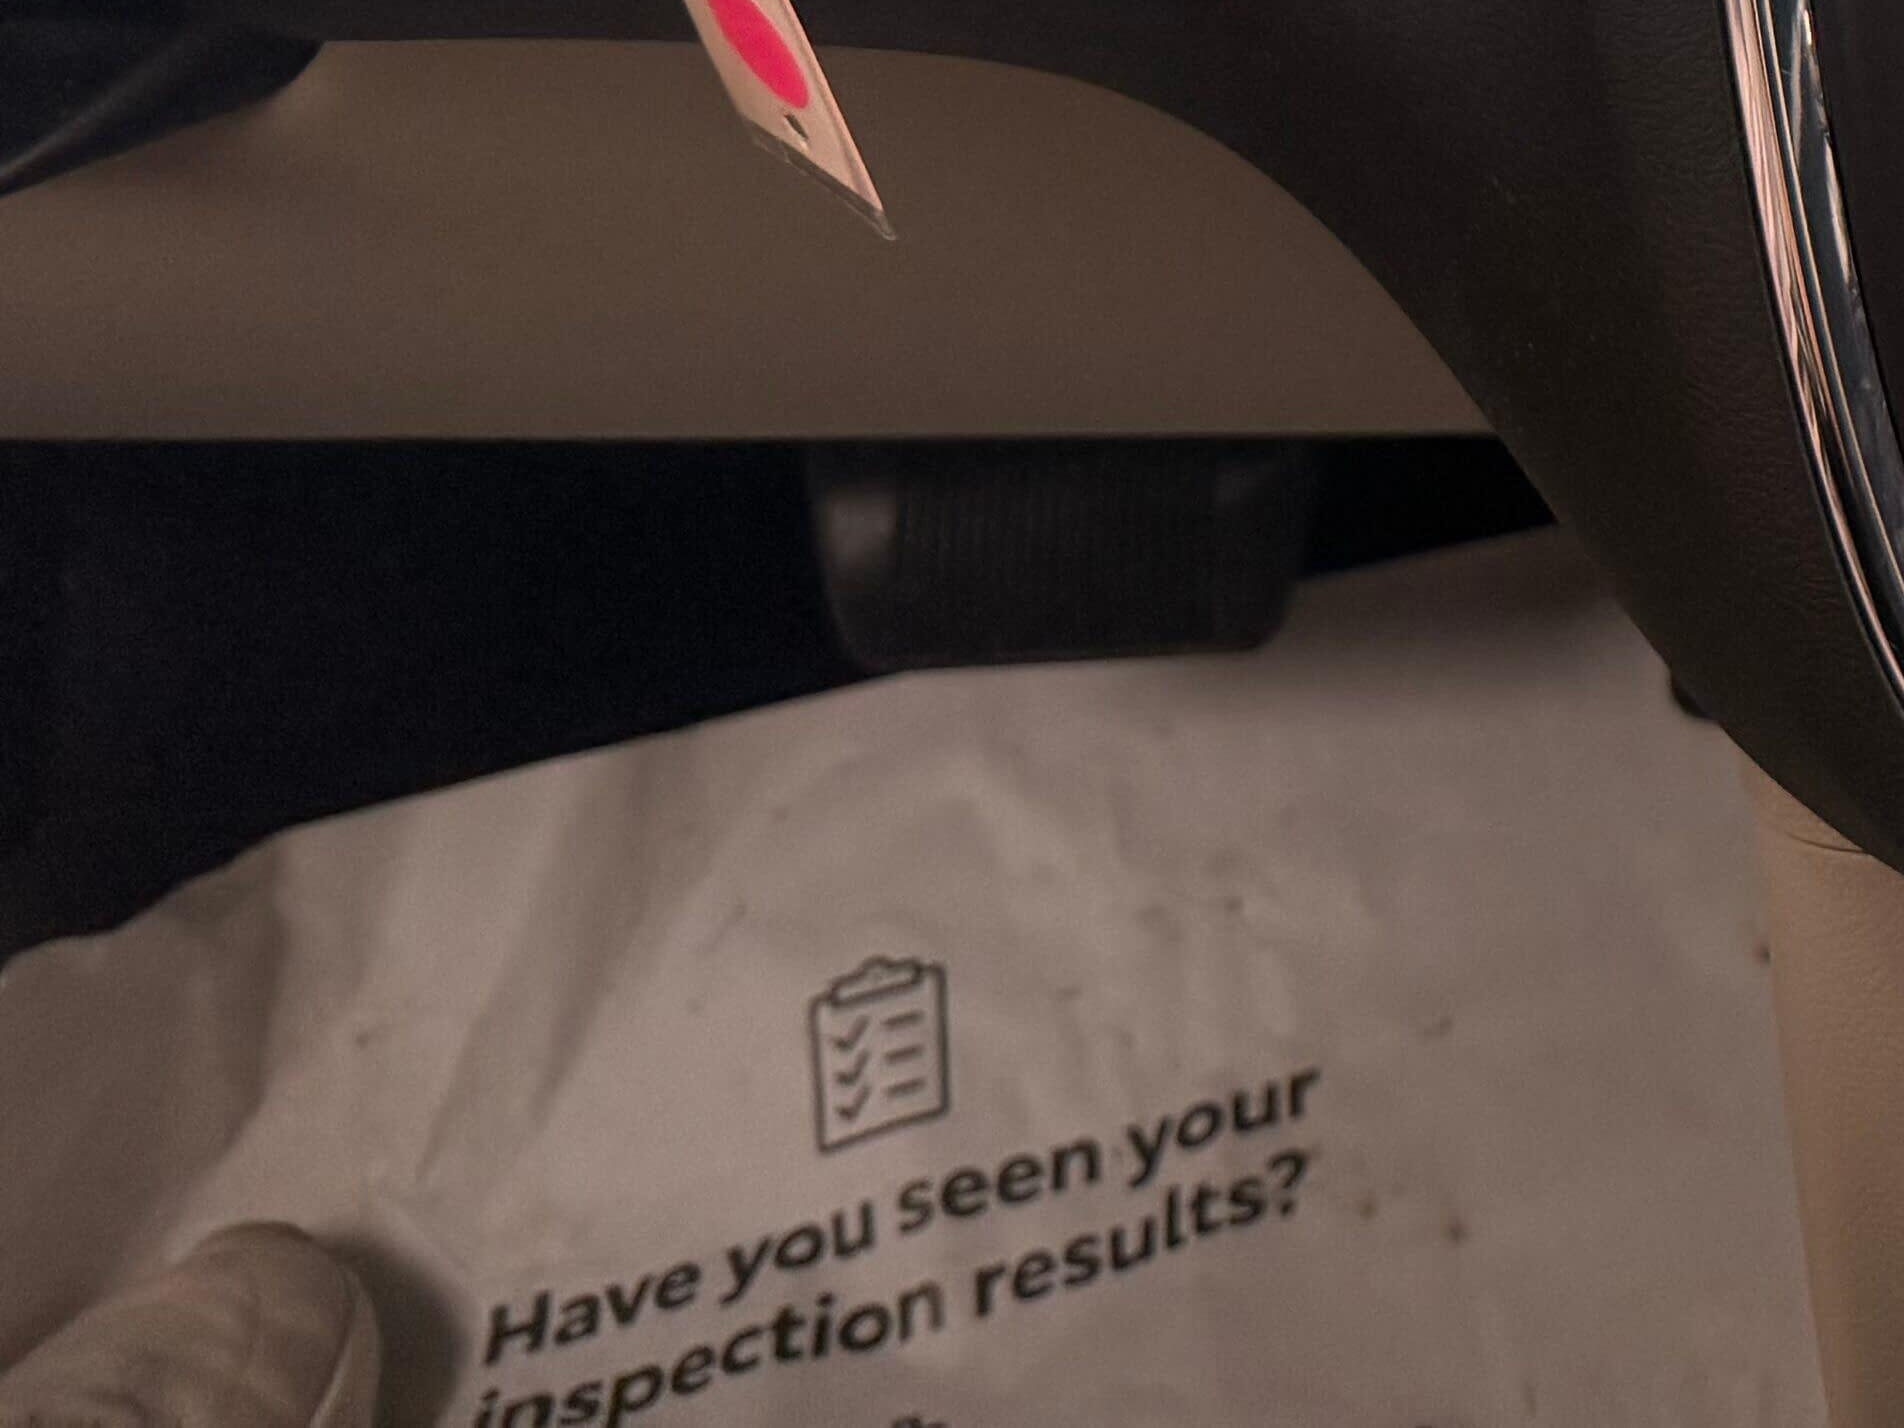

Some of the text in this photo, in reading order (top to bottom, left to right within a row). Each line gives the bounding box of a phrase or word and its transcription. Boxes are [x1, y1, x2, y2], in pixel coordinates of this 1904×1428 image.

[474, 1150, 1310, 1428] inspection results?
[486, 1070, 1320, 1366] Have you seen your
